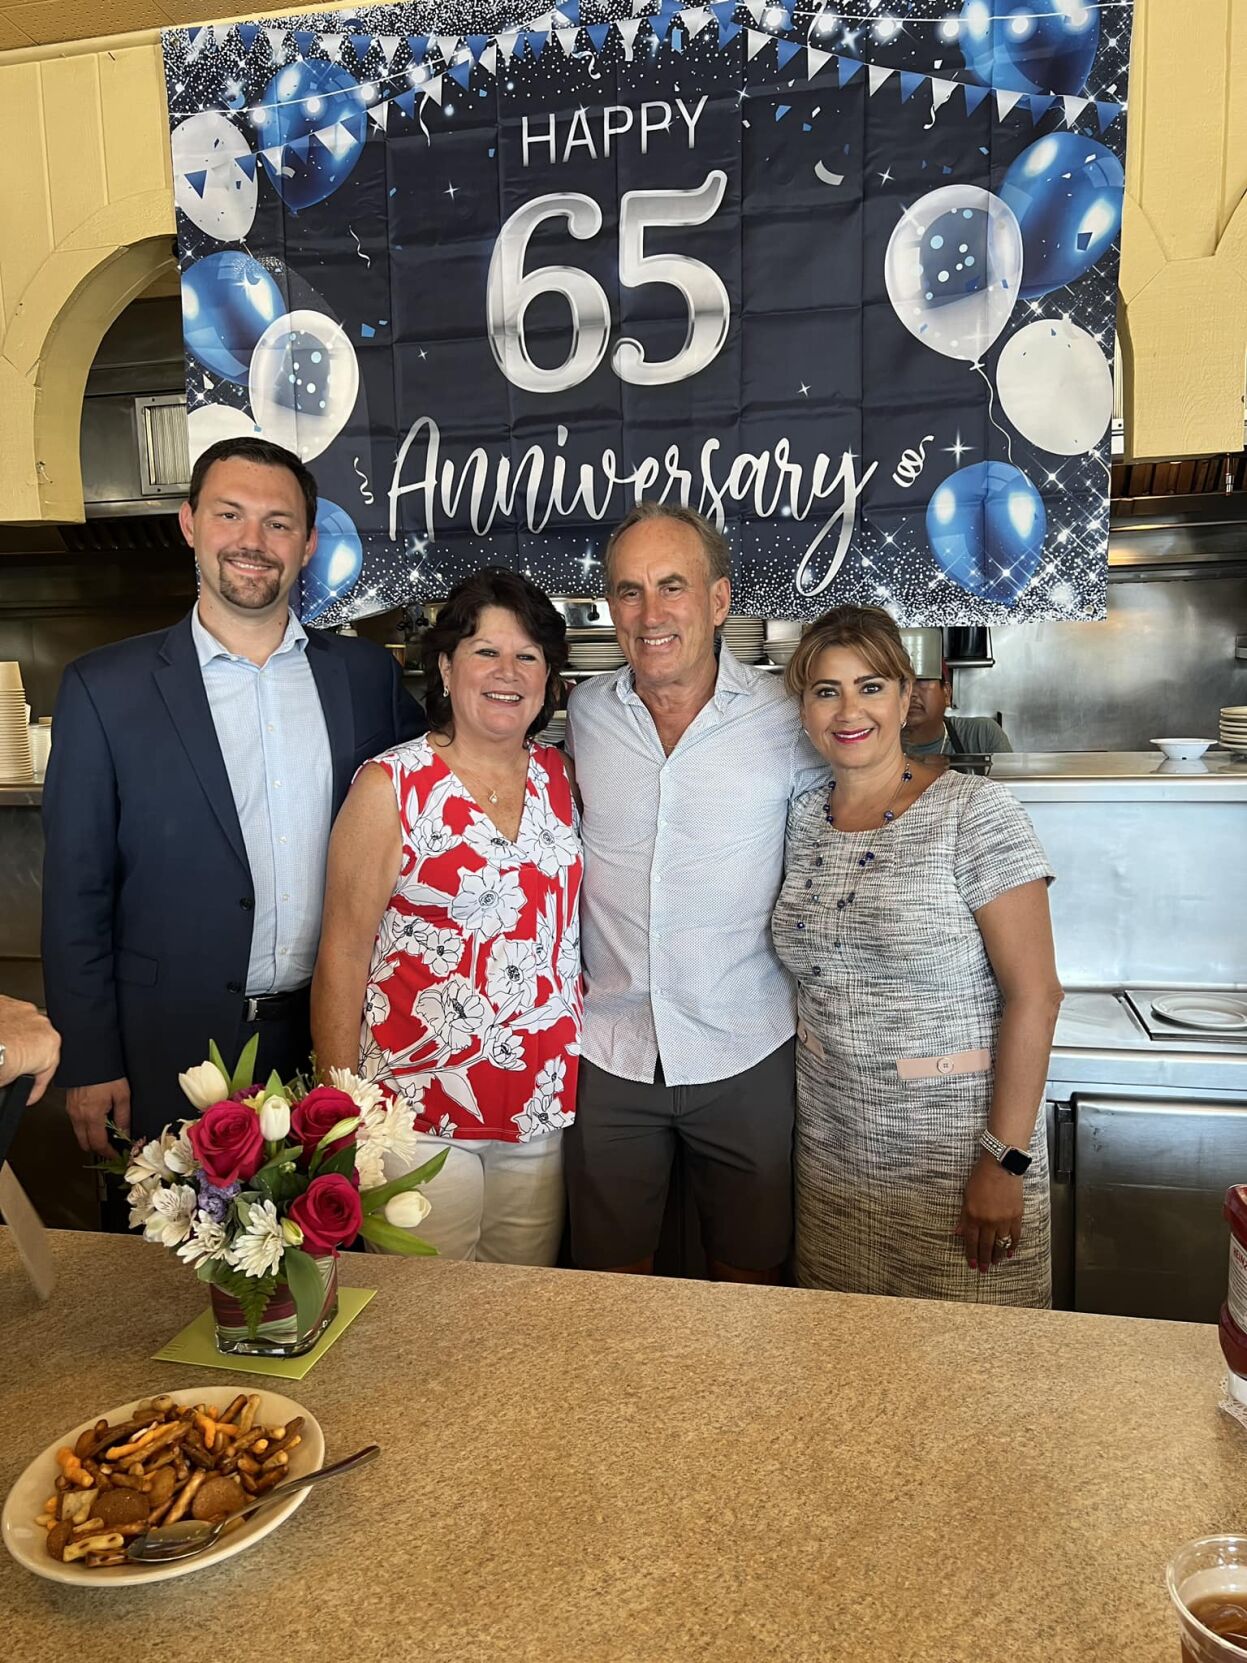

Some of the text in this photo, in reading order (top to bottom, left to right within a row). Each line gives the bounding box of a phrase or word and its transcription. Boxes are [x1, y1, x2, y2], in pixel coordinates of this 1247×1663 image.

[521, 95, 709, 167] HAPPY
[486, 169, 731, 394] 65
[387, 415, 879, 597] Anniversary
